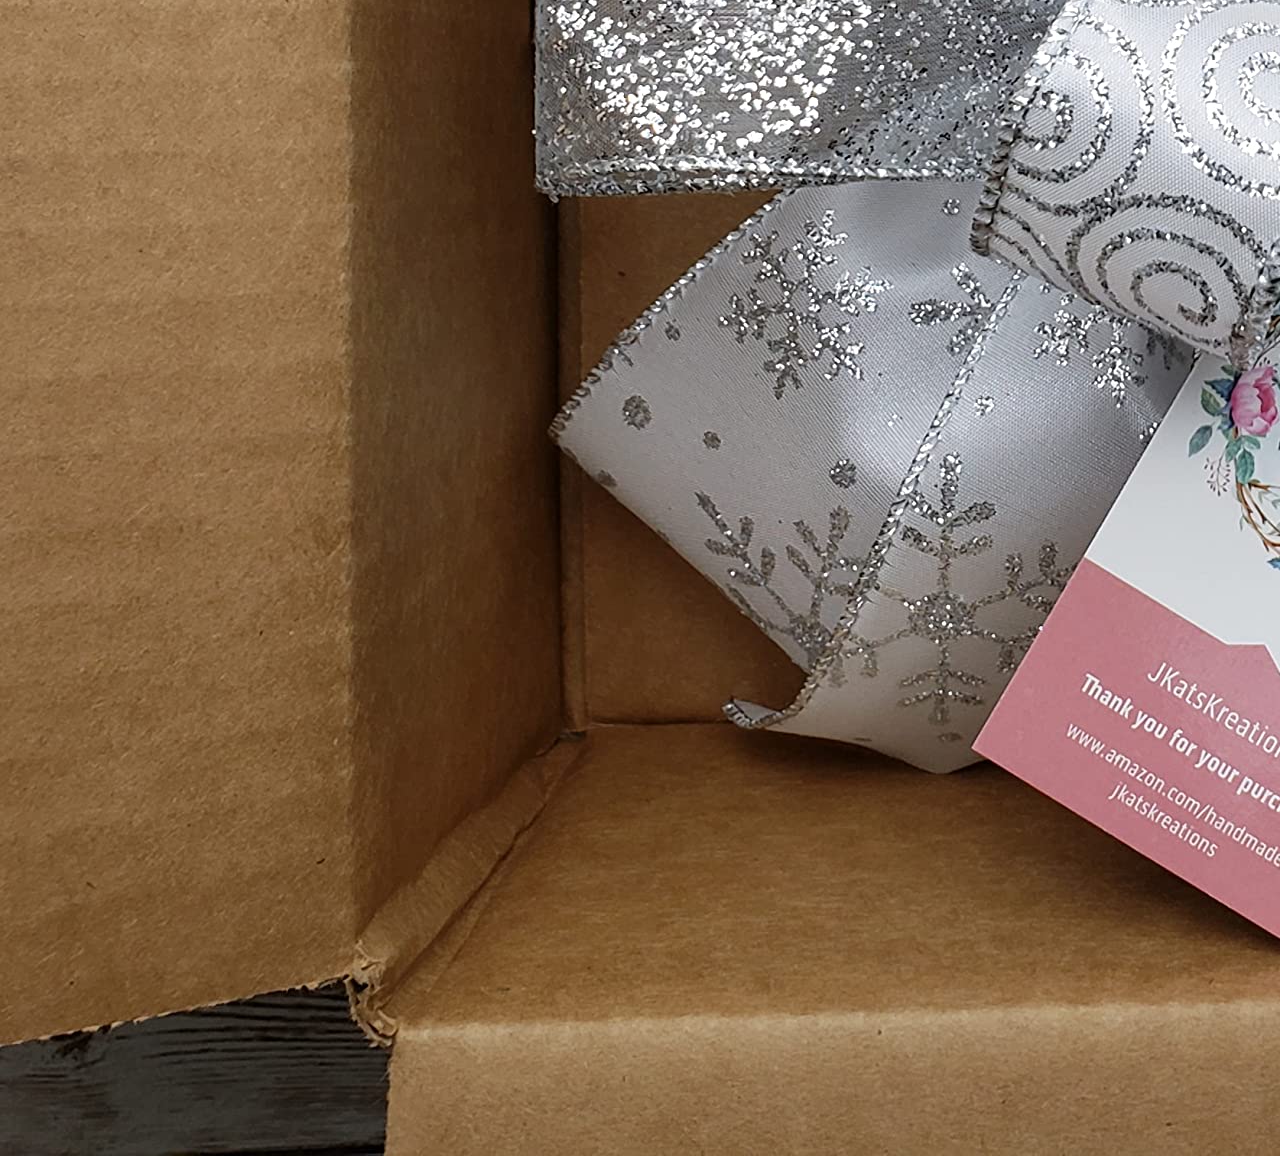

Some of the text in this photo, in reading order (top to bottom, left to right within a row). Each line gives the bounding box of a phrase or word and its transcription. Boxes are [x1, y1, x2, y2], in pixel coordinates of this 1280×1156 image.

[1081, 673, 1135, 720] Thank
[1131, 711, 1168, 740] you
[1168, 730, 1198, 757] for
[1194, 750, 1240, 784] your
[1108, 782, 1219, 858] jkatskreations
